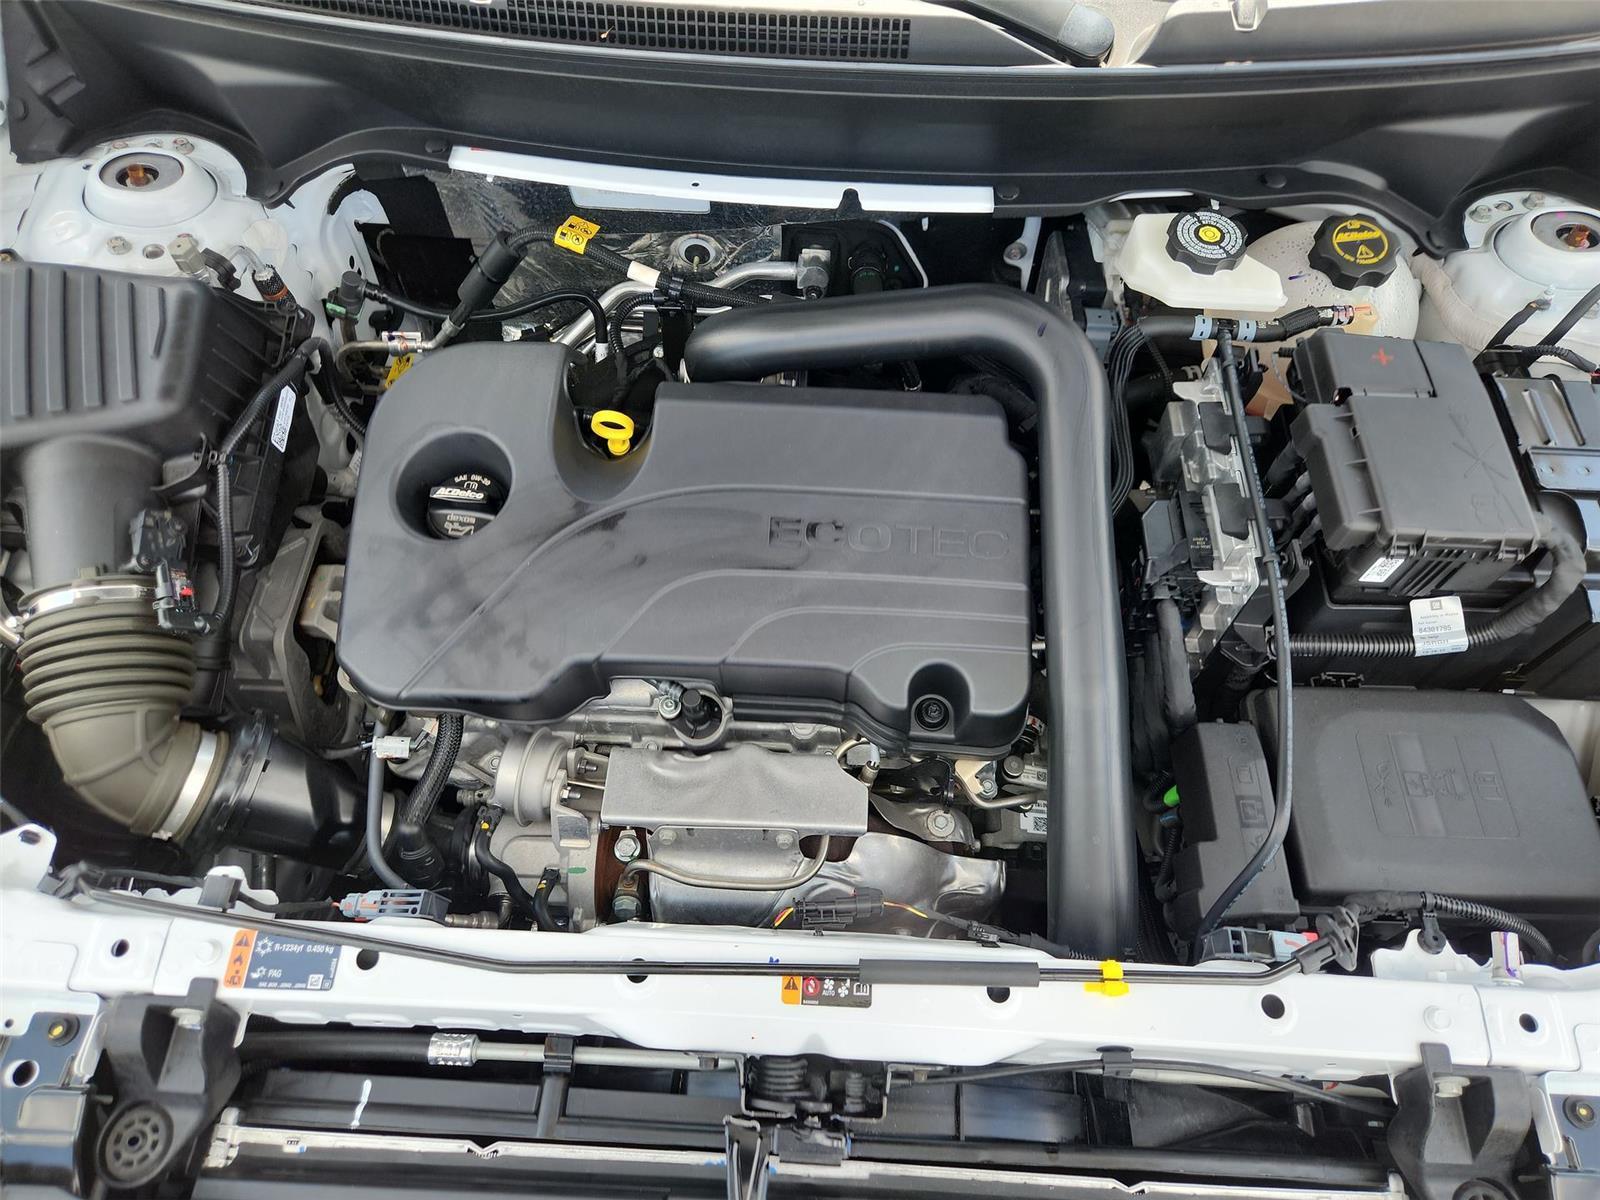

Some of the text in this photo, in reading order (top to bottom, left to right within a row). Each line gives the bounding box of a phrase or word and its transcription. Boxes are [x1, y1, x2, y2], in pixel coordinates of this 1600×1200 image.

[436, 487, 484, 499] ACDelco
[768, 515, 1009, 560] ECOTEC
[325, 945, 335, 955] kg
[267, 969, 283, 978] PAG
[821, 989, 836, 997] AUTO
